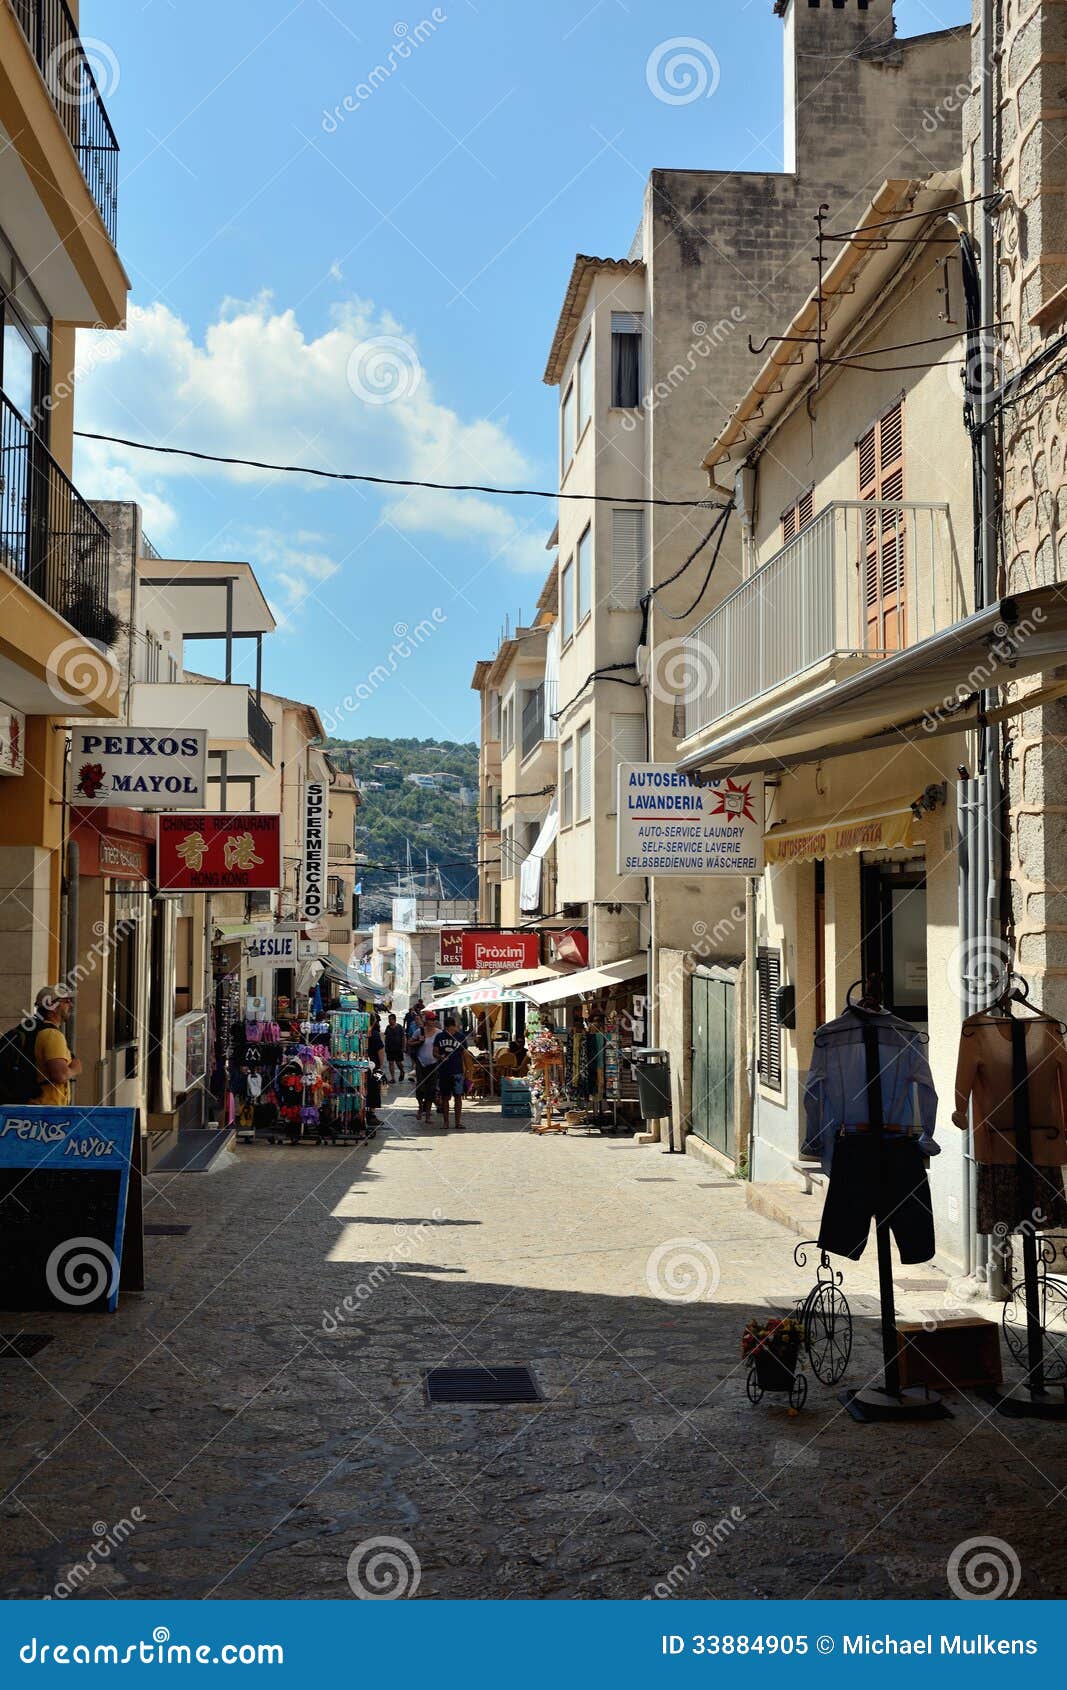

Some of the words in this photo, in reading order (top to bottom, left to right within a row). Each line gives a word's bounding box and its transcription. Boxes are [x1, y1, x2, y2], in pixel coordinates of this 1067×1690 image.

[81, 735, 198, 757] PEIXOS
[111, 774, 198, 793] MAYOL
[628, 795, 703, 810] LAVANDERIA
[162, 818, 205, 832] CHINESE
[213, 818, 276, 832] RESTAURANT
[638, 826, 701, 838] AUTO-SERVICE
[703, 827, 745, 838] LAUNDRY
[305, 784, 323, 916] SUPERMERCADO
[641, 842, 702, 853] SELF-SERVICE
[705, 842, 741, 853] LAVERIE
[190, 872, 219, 886] HONG
[221, 872, 249, 886] KONG
[477, 945, 522, 958] Pròxim
[475, 960, 523, 969] SUPERMARKET
